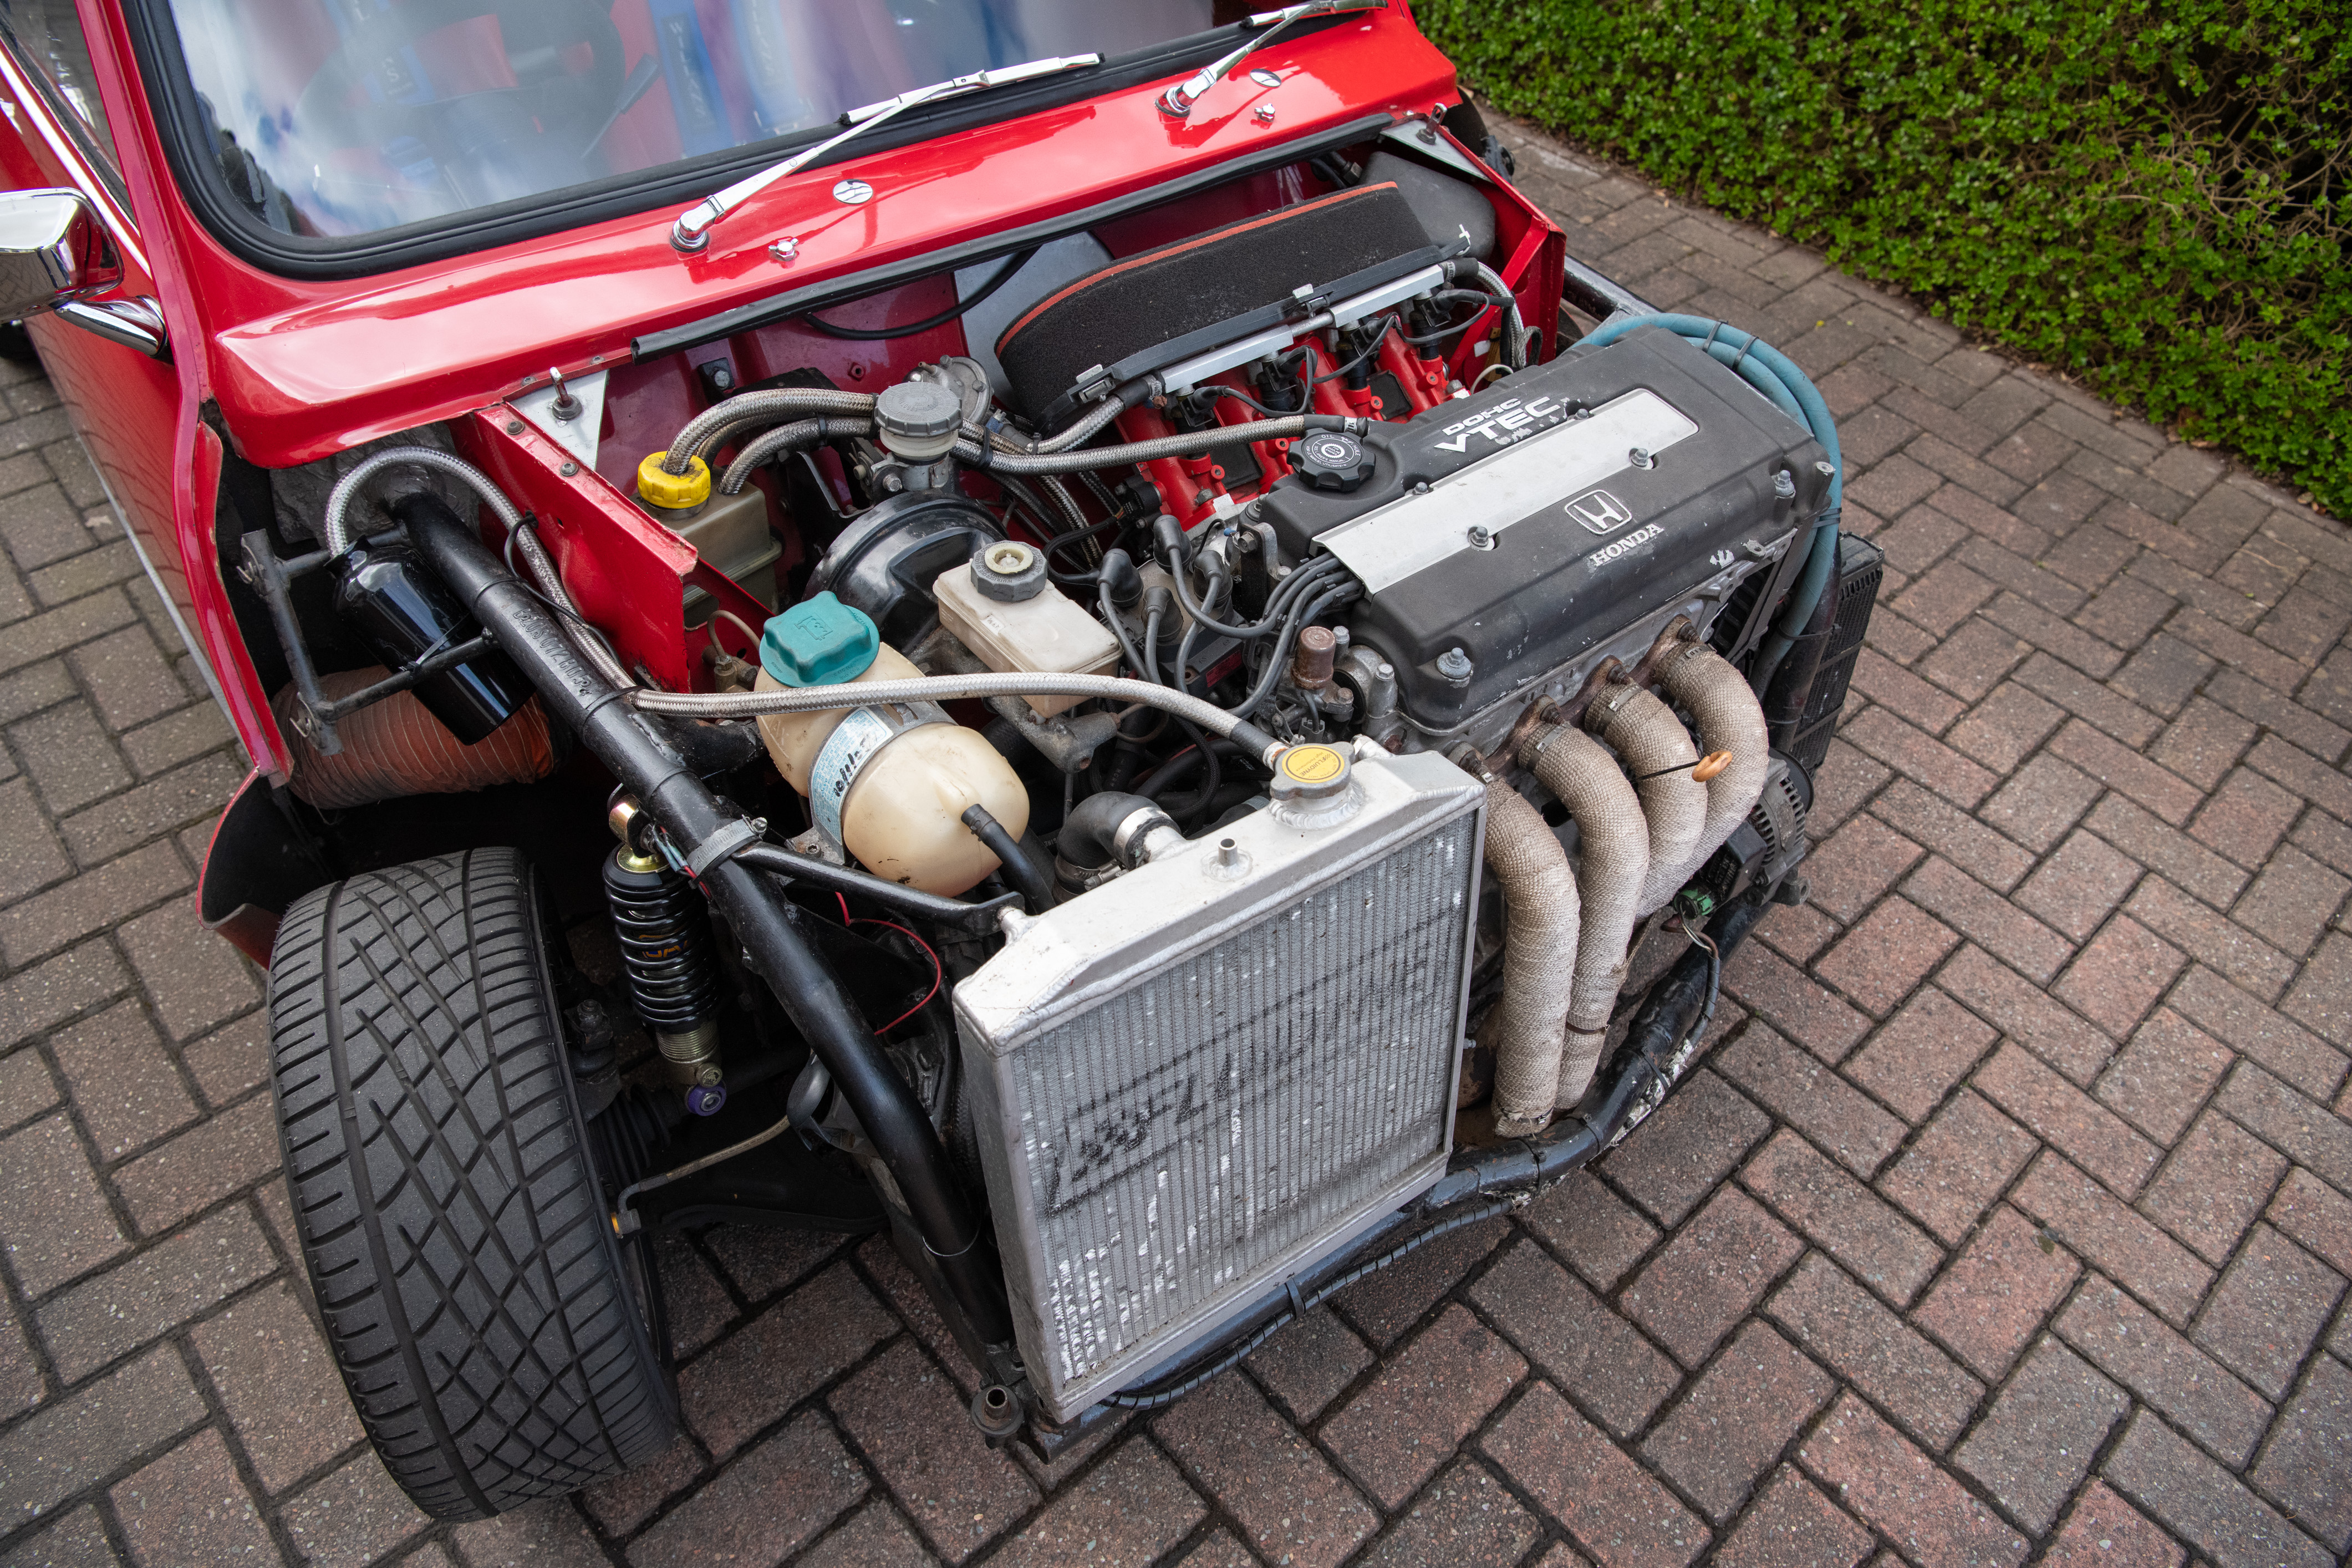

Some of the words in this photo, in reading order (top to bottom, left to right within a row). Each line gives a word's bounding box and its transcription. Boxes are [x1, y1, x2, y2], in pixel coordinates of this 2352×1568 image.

[1434, 396, 1561, 452] VTEC
[1442, 398, 1521, 436] DOHC
[1352, 445, 1361, 456] HUILE
[1310, 455, 1322, 465] MANUEL
[1590, 523, 1664, 567] HONDA
[1314, 751, 1323, 760] High
[1295, 757, 1316, 772] Performance
[1300, 757, 1326, 777] FLUIDYNE
